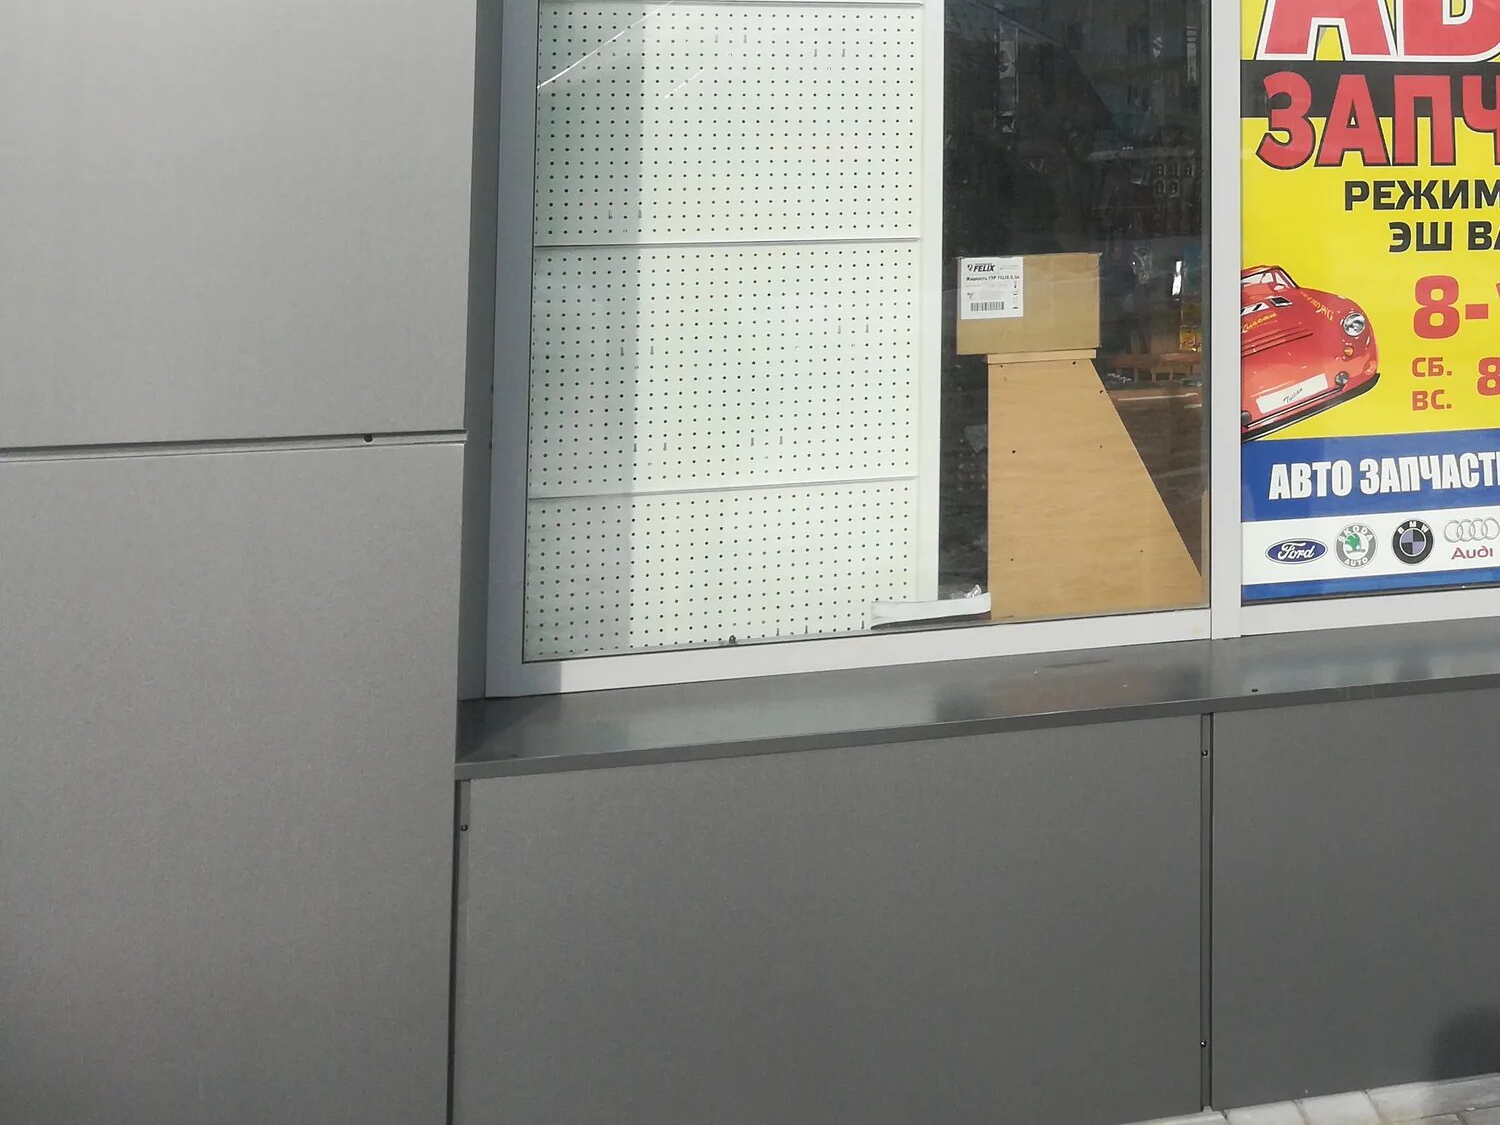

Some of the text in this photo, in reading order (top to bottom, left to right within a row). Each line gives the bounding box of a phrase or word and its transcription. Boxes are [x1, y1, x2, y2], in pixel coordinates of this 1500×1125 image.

[1388, 221, 1453, 252] ЭШ
[1411, 357, 1452, 378] СБ.
[1412, 389, 1452, 411] ВС.
[1268, 460, 1352, 500] АВТО
[1397, 521, 1430, 535] BMW
[1277, 542, 1315, 560] Ford
[1451, 546, 1493, 560] Audi
